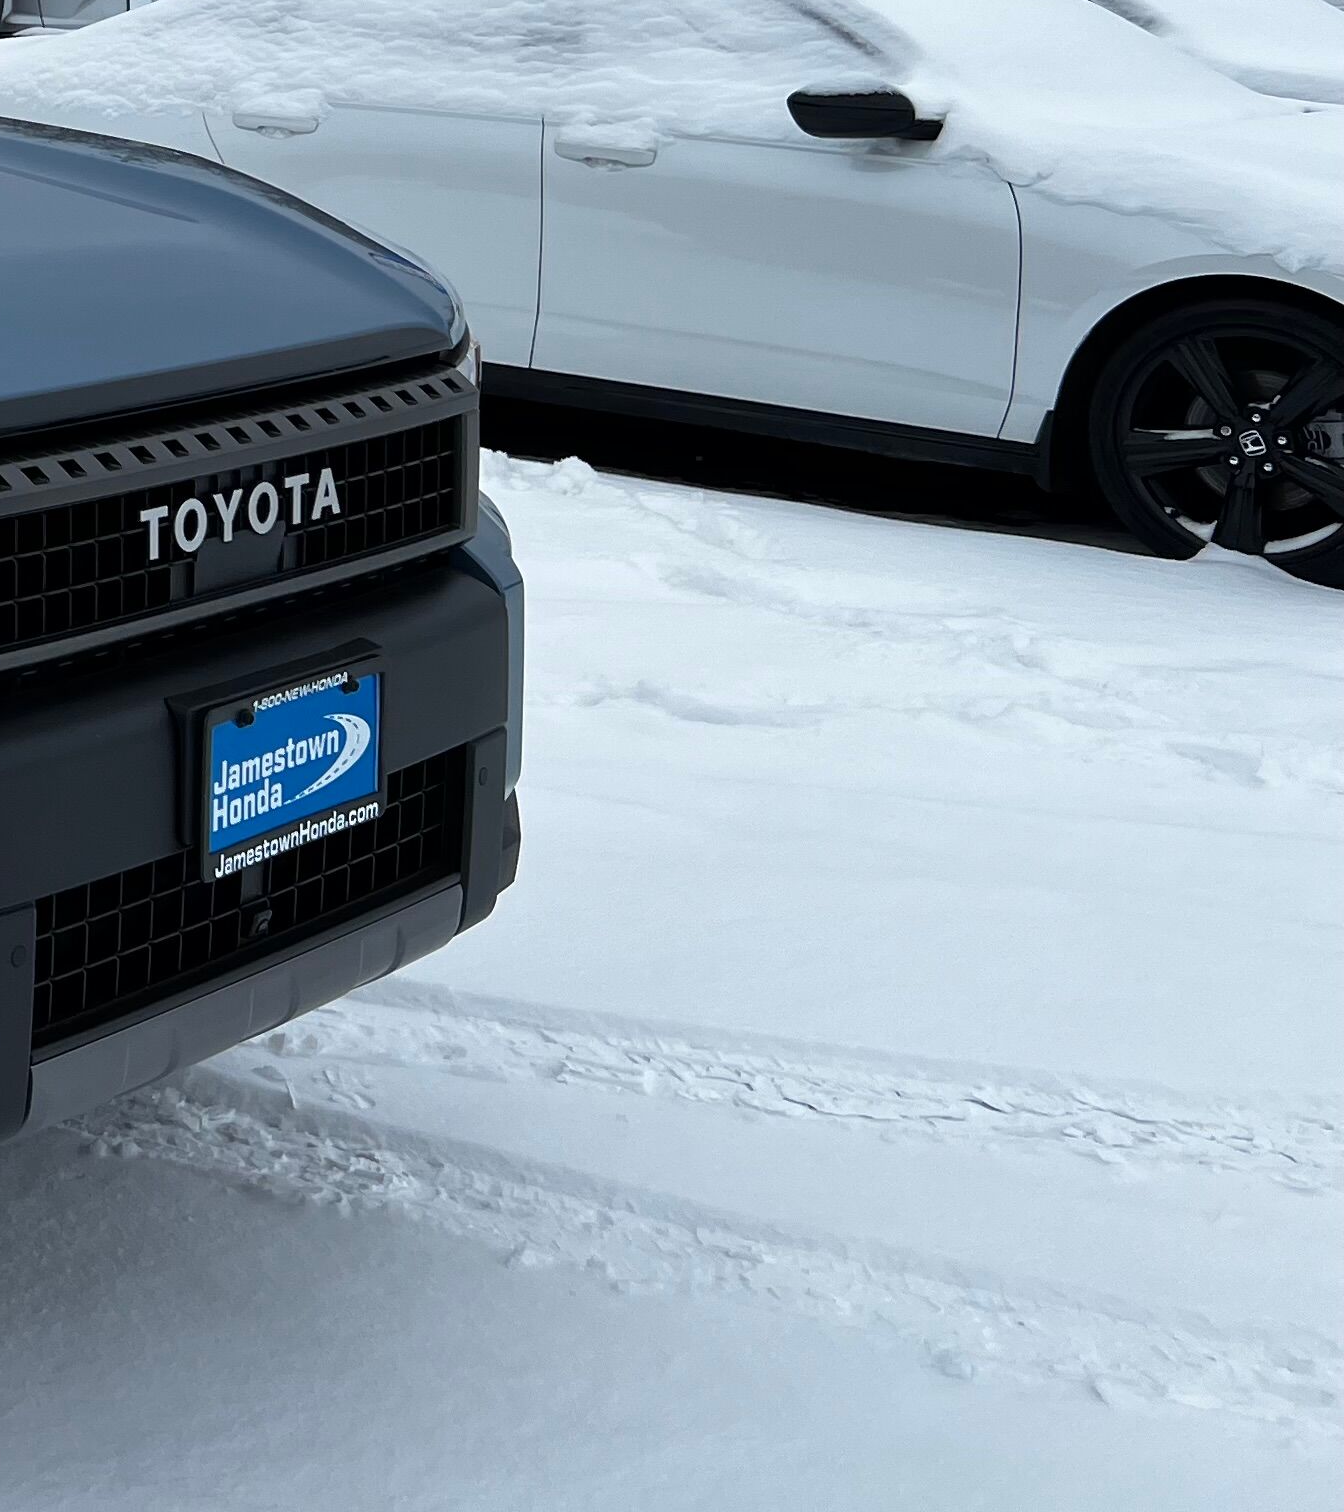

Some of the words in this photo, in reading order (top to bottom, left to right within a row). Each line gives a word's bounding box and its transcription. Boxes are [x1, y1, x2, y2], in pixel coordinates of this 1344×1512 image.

[139, 467, 342, 561] TOYOTA
[251, 671, 349, 713] 1-800-NEW-HONDA
[211, 729, 340, 796] Jamestown
[211, 778, 283, 832] Honda
[214, 800, 380, 879] JamestownHonda.com
